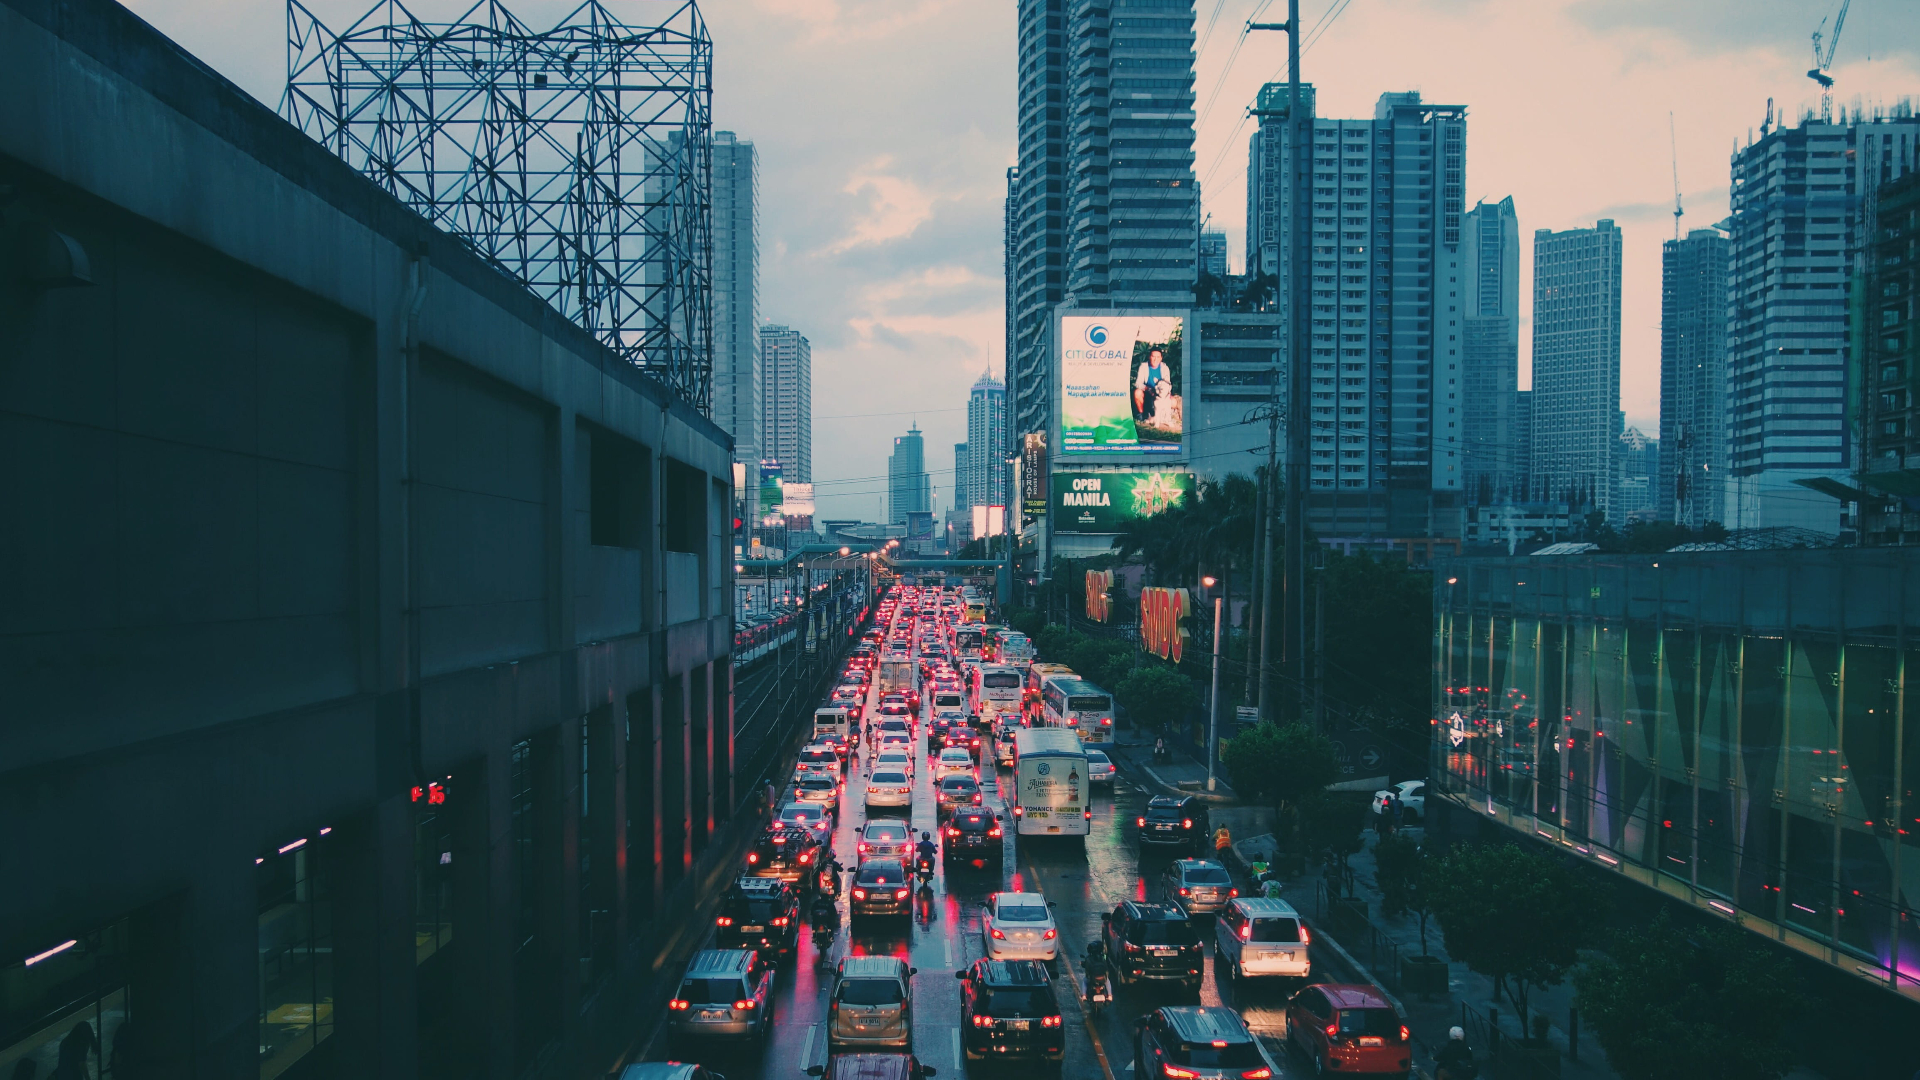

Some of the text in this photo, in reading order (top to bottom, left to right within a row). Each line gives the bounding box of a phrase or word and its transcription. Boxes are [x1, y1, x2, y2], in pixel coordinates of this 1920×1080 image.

[1065, 350, 1128, 360] CITIGLOBAL
[1072, 478, 1102, 492] OPEN
[1063, 493, 1110, 507] MANILA
[1140, 586, 1191, 664] SMDC
